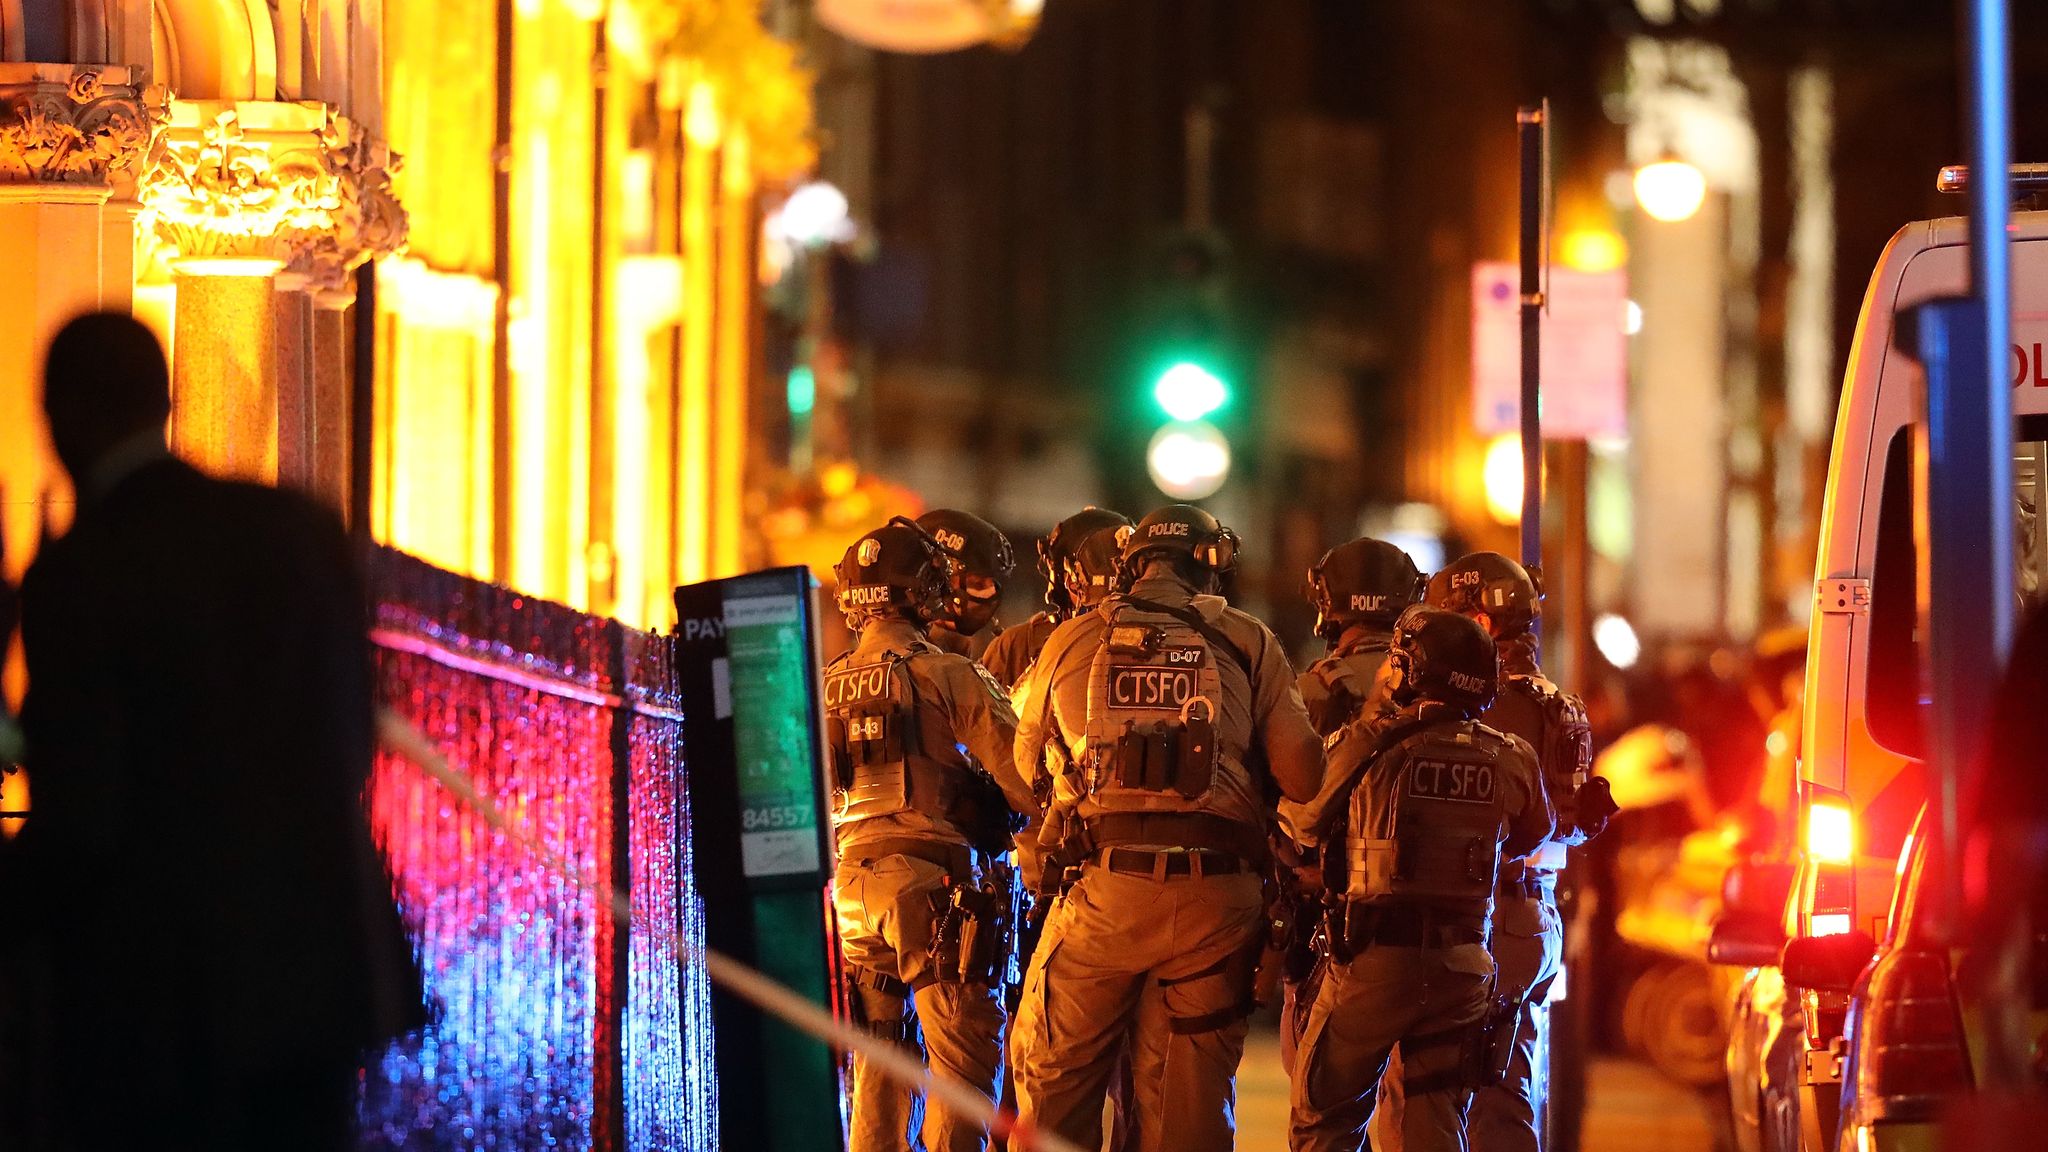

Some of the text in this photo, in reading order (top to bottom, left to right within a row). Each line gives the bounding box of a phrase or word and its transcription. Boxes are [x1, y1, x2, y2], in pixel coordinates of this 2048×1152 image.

[1149, 522, 1189, 538] POLICE
[1452, 570, 1480, 589] E-03
[851, 586, 889, 605] POLICE
[685, 616, 727, 641] PAY
[1170, 650, 1201, 663] D-07
[825, 667, 884, 706] CTSFO
[1115, 671, 1191, 705] CTSFO
[1448, 671, 1486, 694] POLICE
[852, 721, 879, 736] D-03
[743, 805, 811, 829] 84557
